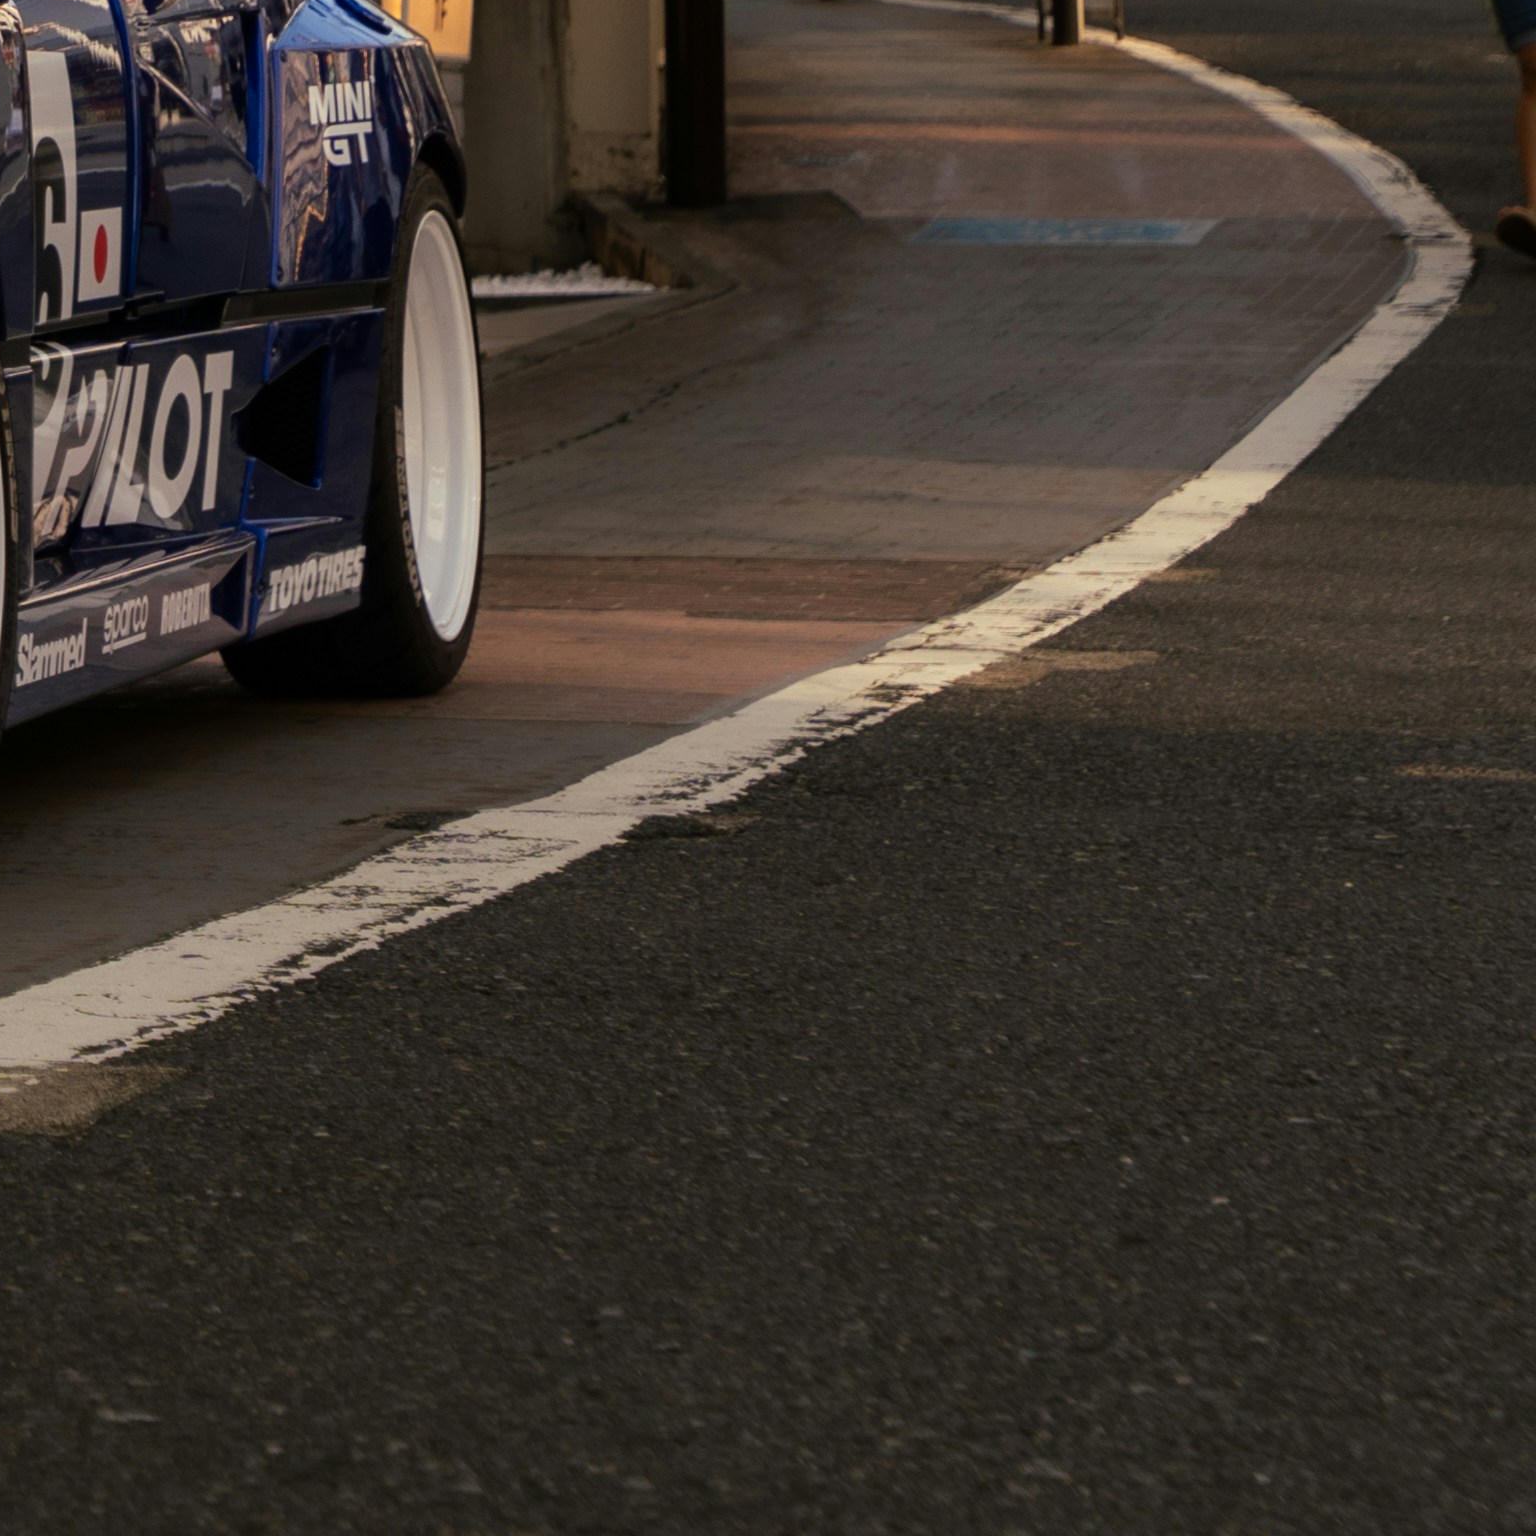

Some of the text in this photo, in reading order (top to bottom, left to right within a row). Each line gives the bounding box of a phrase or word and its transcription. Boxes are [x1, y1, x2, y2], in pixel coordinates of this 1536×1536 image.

[309, 80, 371, 125] MINI
[322, 121, 373, 164] GT
[39, 349, 234, 537] PILOT
[269, 545, 367, 612] TOYO TIRES
[15, 617, 88, 688] Slammed
[103, 595, 149, 654] sparco
